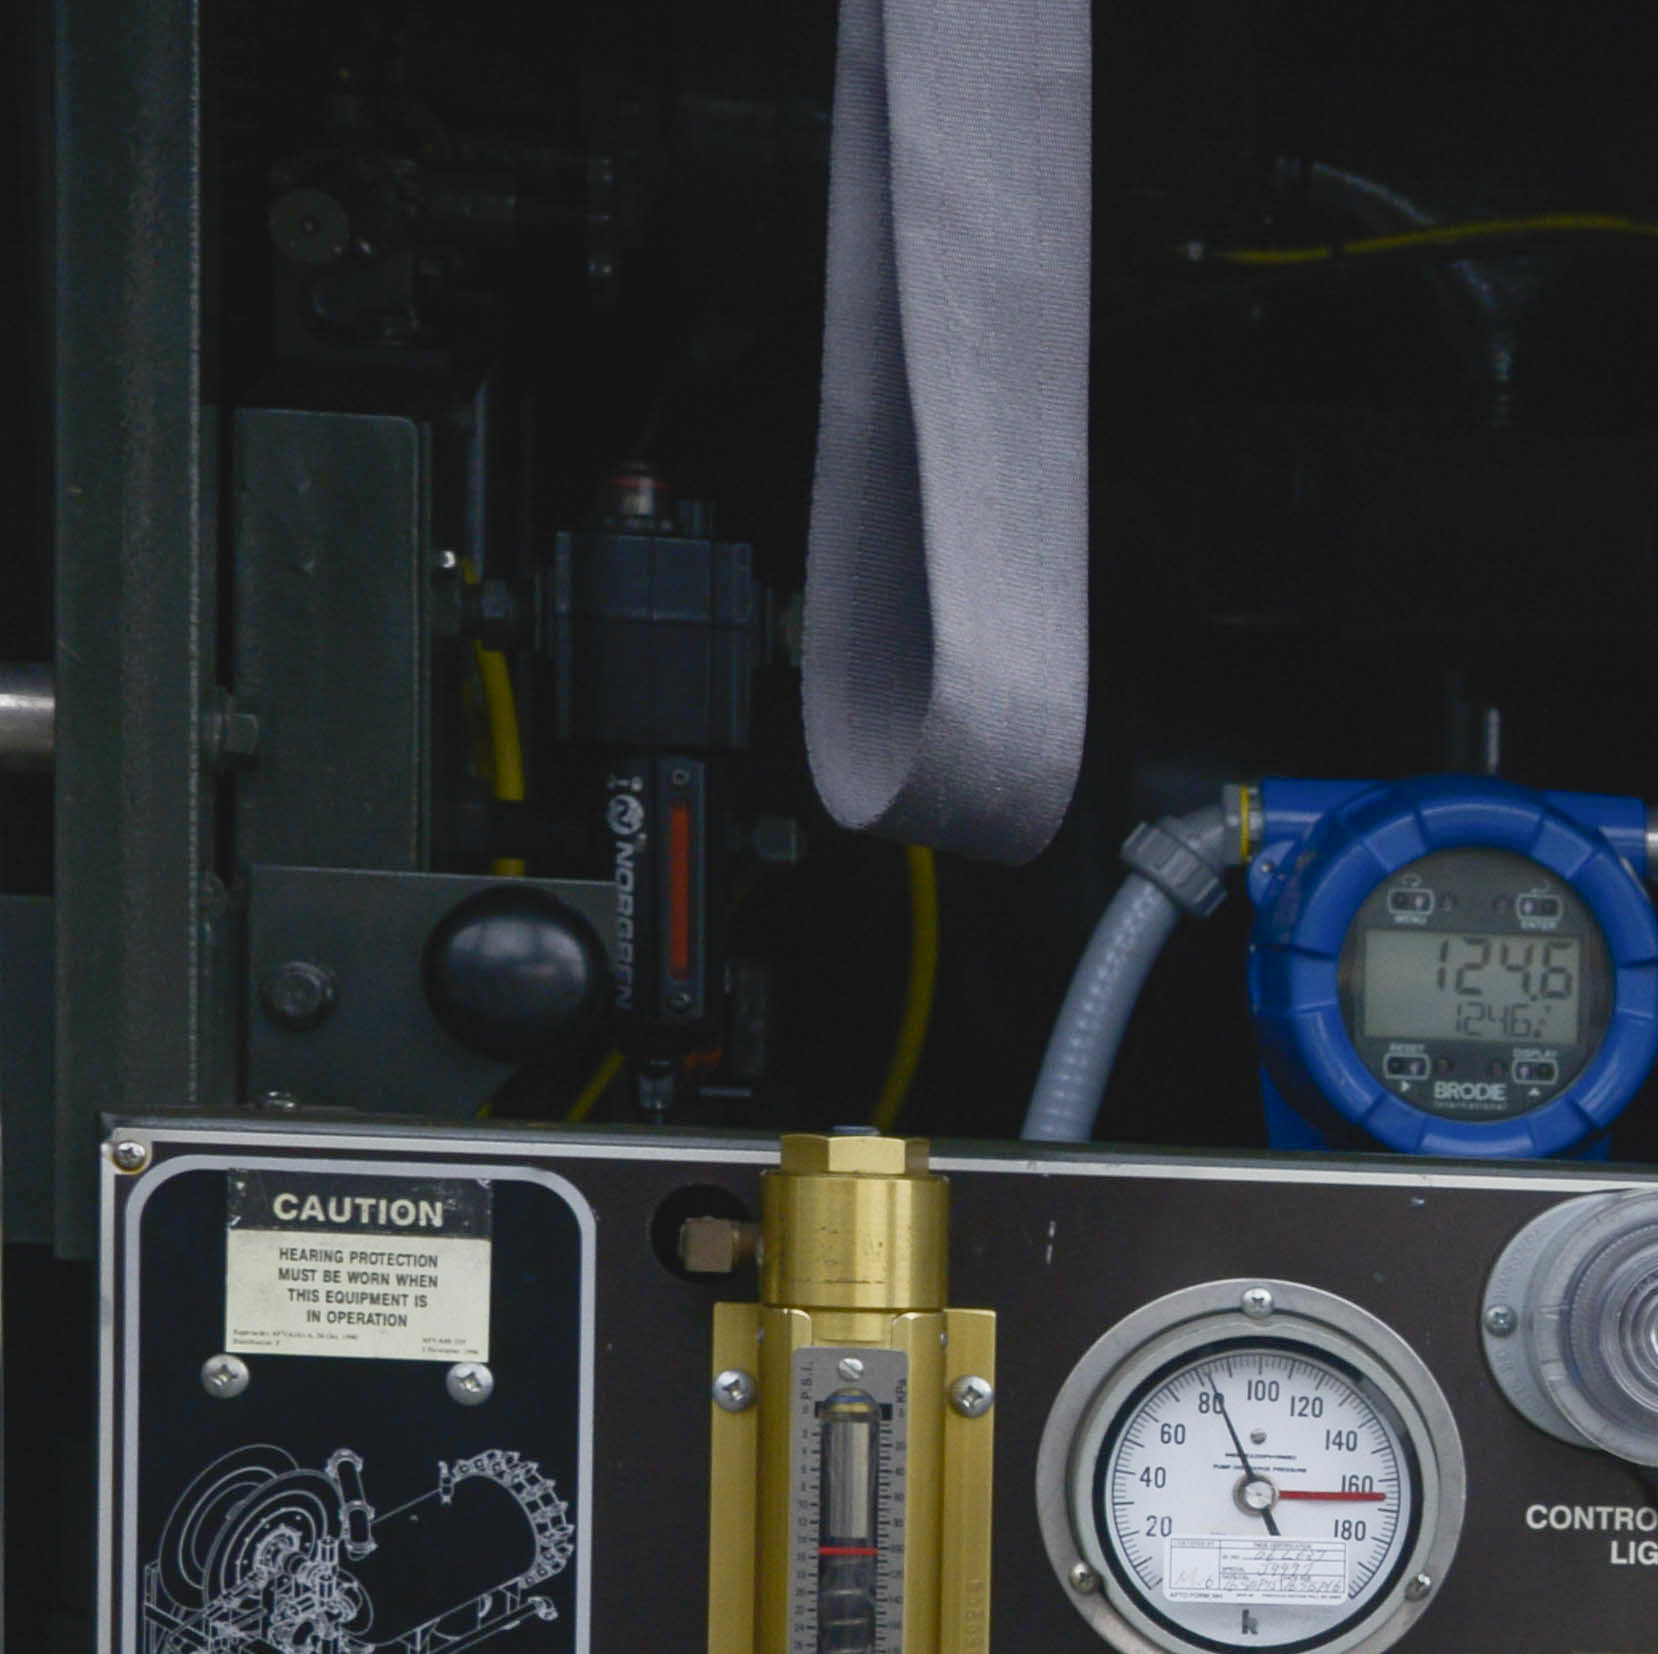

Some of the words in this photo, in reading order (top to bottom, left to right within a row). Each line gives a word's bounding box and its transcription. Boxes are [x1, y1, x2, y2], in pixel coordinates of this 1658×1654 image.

[1433, 1081, 1507, 1100] BRODIE
[273, 1193, 444, 1228] CAUTION
[278, 1247, 344, 1265] HEARING
[348, 1249, 439, 1268] PROTECTION
[278, 1268, 319, 1284] MUST
[322, 1269, 342, 1285] BE
[346, 1270, 390, 1287] WORN
[395, 1272, 439, 1288] WHEN
[287, 1288, 321, 1304] THIS
[325, 1290, 409, 1307] EQUIPMENT
[414, 1293, 428, 1308] IS
[306, 1309, 322, 1324] IN
[326, 1310, 408, 1327] OPERATION
[1247, 1380, 1280, 1402] 100
[1289, 1396, 1324, 1418] 120
[1159, 1423, 1186, 1446] 60
[1325, 1430, 1358, 1452] 140
[1139, 1466, 1167, 1489] 40
[1146, 1516, 1172, 1538] 20
[1333, 1519, 1367, 1542] 180
